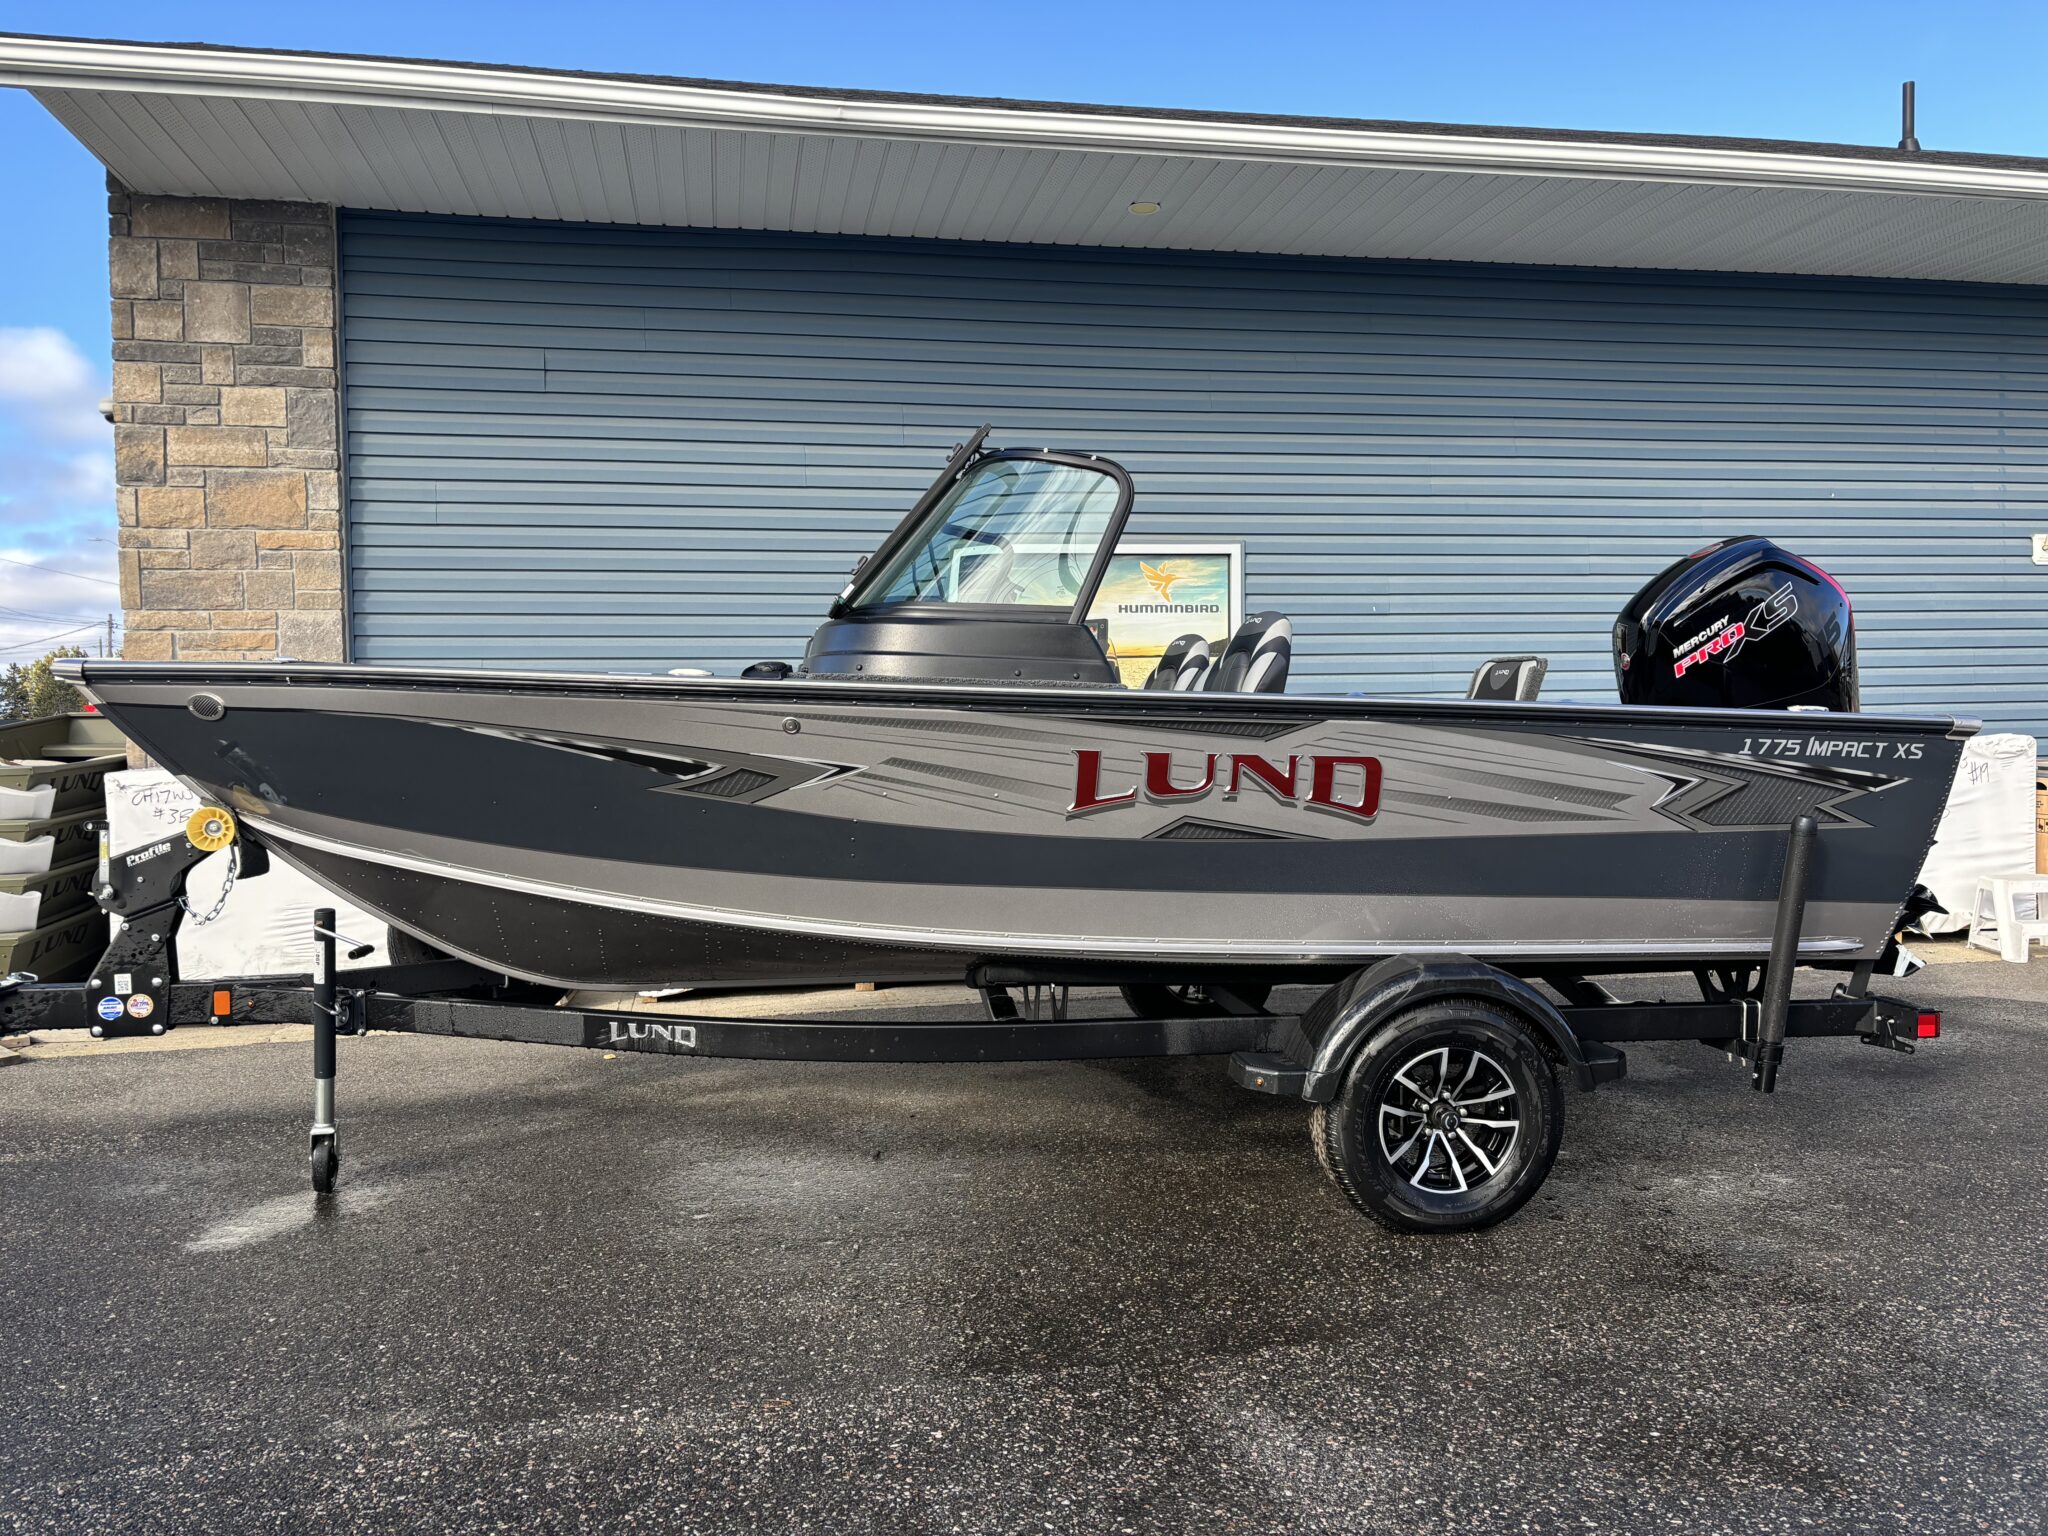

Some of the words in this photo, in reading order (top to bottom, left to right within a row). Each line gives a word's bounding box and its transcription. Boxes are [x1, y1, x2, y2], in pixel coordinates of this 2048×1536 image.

[1118, 604, 1220, 614] HUMMINBIRD
[1673, 615, 1729, 658] MERCURY
[1738, 738, 1802, 756] 1775
[1805, 736, 1888, 758] IMPACT
[1893, 743, 1925, 759] XS
[1065, 748, 1384, 822] LUND
[46, 822, 96, 845] UND
[126, 842, 171, 866] Profile
[27, 923, 88, 968] LUND
[609, 1021, 697, 1048] LUND
